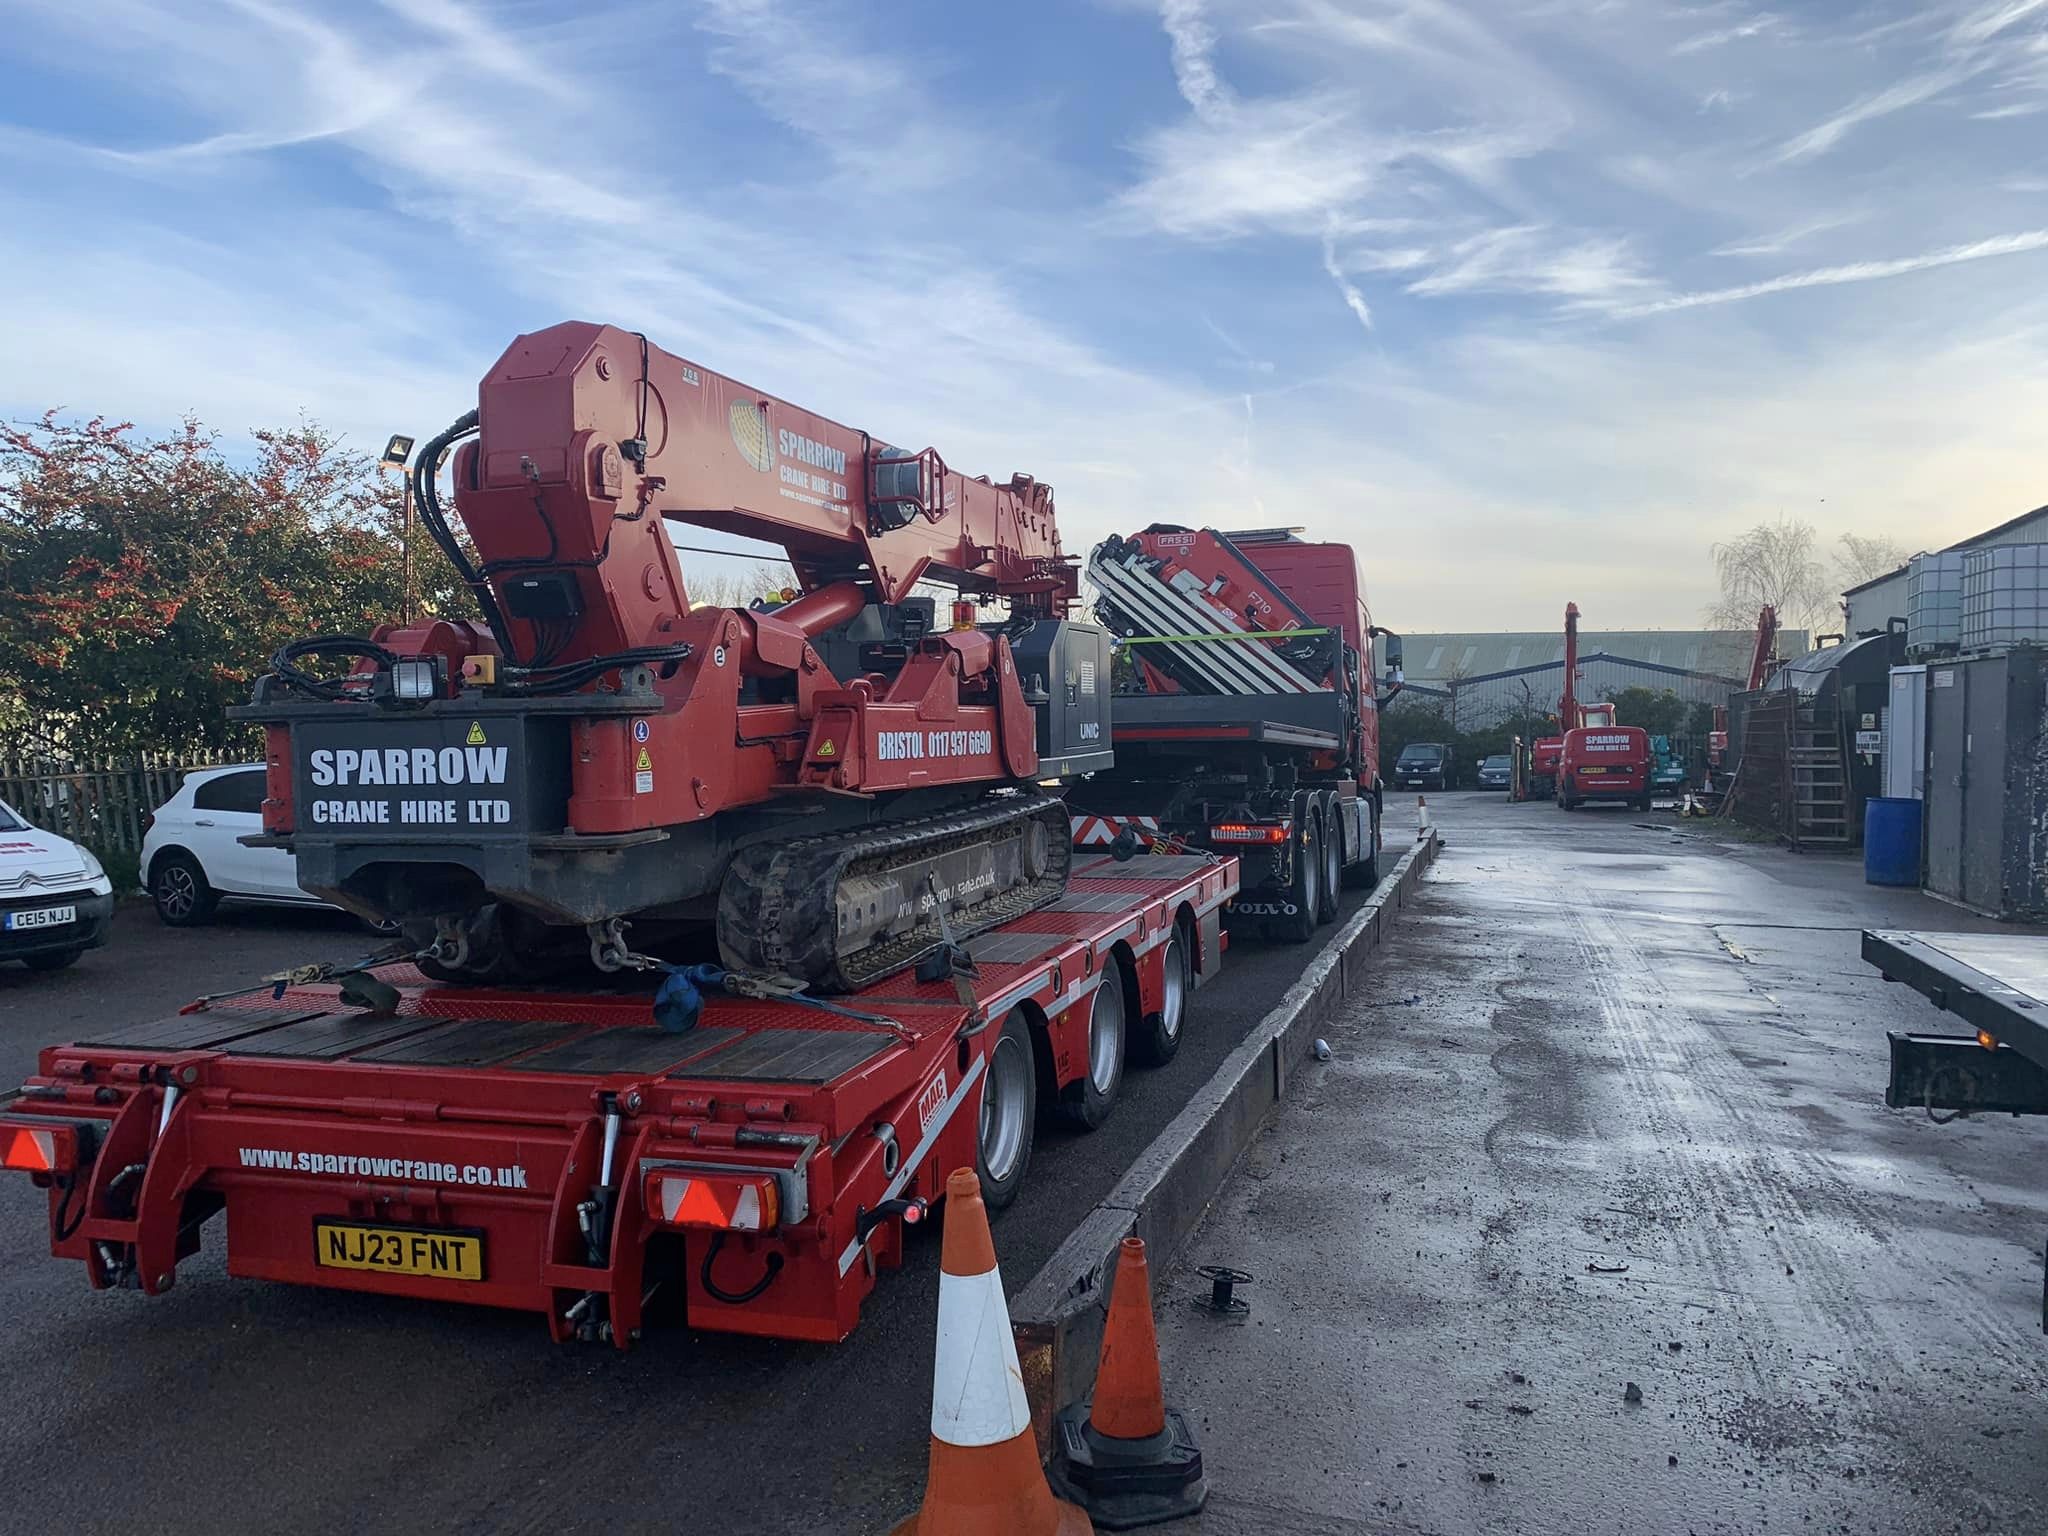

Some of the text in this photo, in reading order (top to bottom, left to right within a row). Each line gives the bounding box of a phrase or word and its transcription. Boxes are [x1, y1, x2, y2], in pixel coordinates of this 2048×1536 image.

[779, 428, 846, 475] SPARROW
[780, 464, 847, 500] CRANE HIRE LTD
[1160, 534, 1194, 545] FASSI
[1247, 591, 1272, 614] F710
[1080, 722, 1099, 740] UNIC
[1585, 735, 1630, 745] SPARROW
[878, 730, 992, 760] BRISTOL 0117 937 6690
[310, 747, 508, 786] SPARROW
[312, 800, 511, 823] CRANE HIRE LTD
[17, 908, 72, 927] CE15 NJJ
[1225, 902, 1298, 915] VOLVO
[921, 1079, 943, 1122] MAC
[239, 1147, 528, 1189] www.sparrowcrane.co.uk
[329, 1230, 466, 1272] NJ23 FNT
